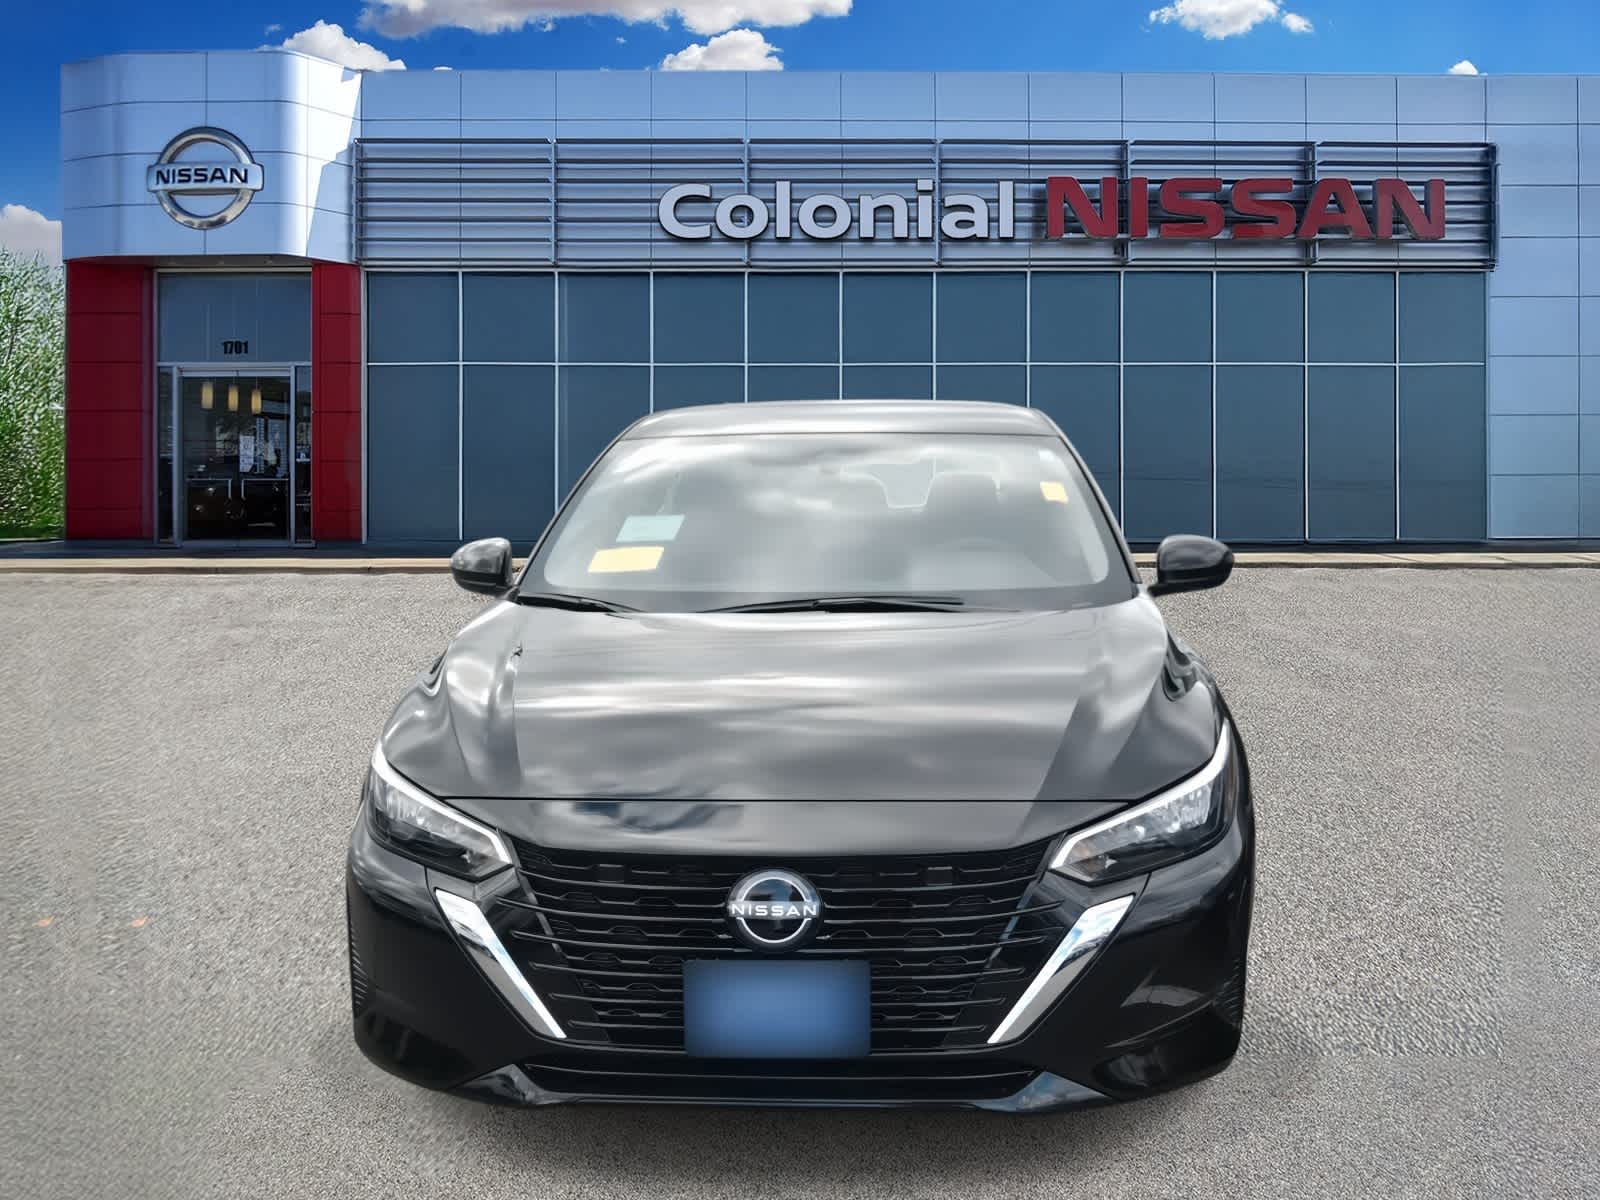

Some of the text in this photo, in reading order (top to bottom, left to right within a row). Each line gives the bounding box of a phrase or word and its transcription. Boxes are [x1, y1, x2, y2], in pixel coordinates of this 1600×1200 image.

[156, 168, 248, 185] NISSAN
[658, 176, 1446, 240] Colonial NISSAN
[223, 341, 249, 354] 1701
[732, 904, 817, 917] NISSAN
